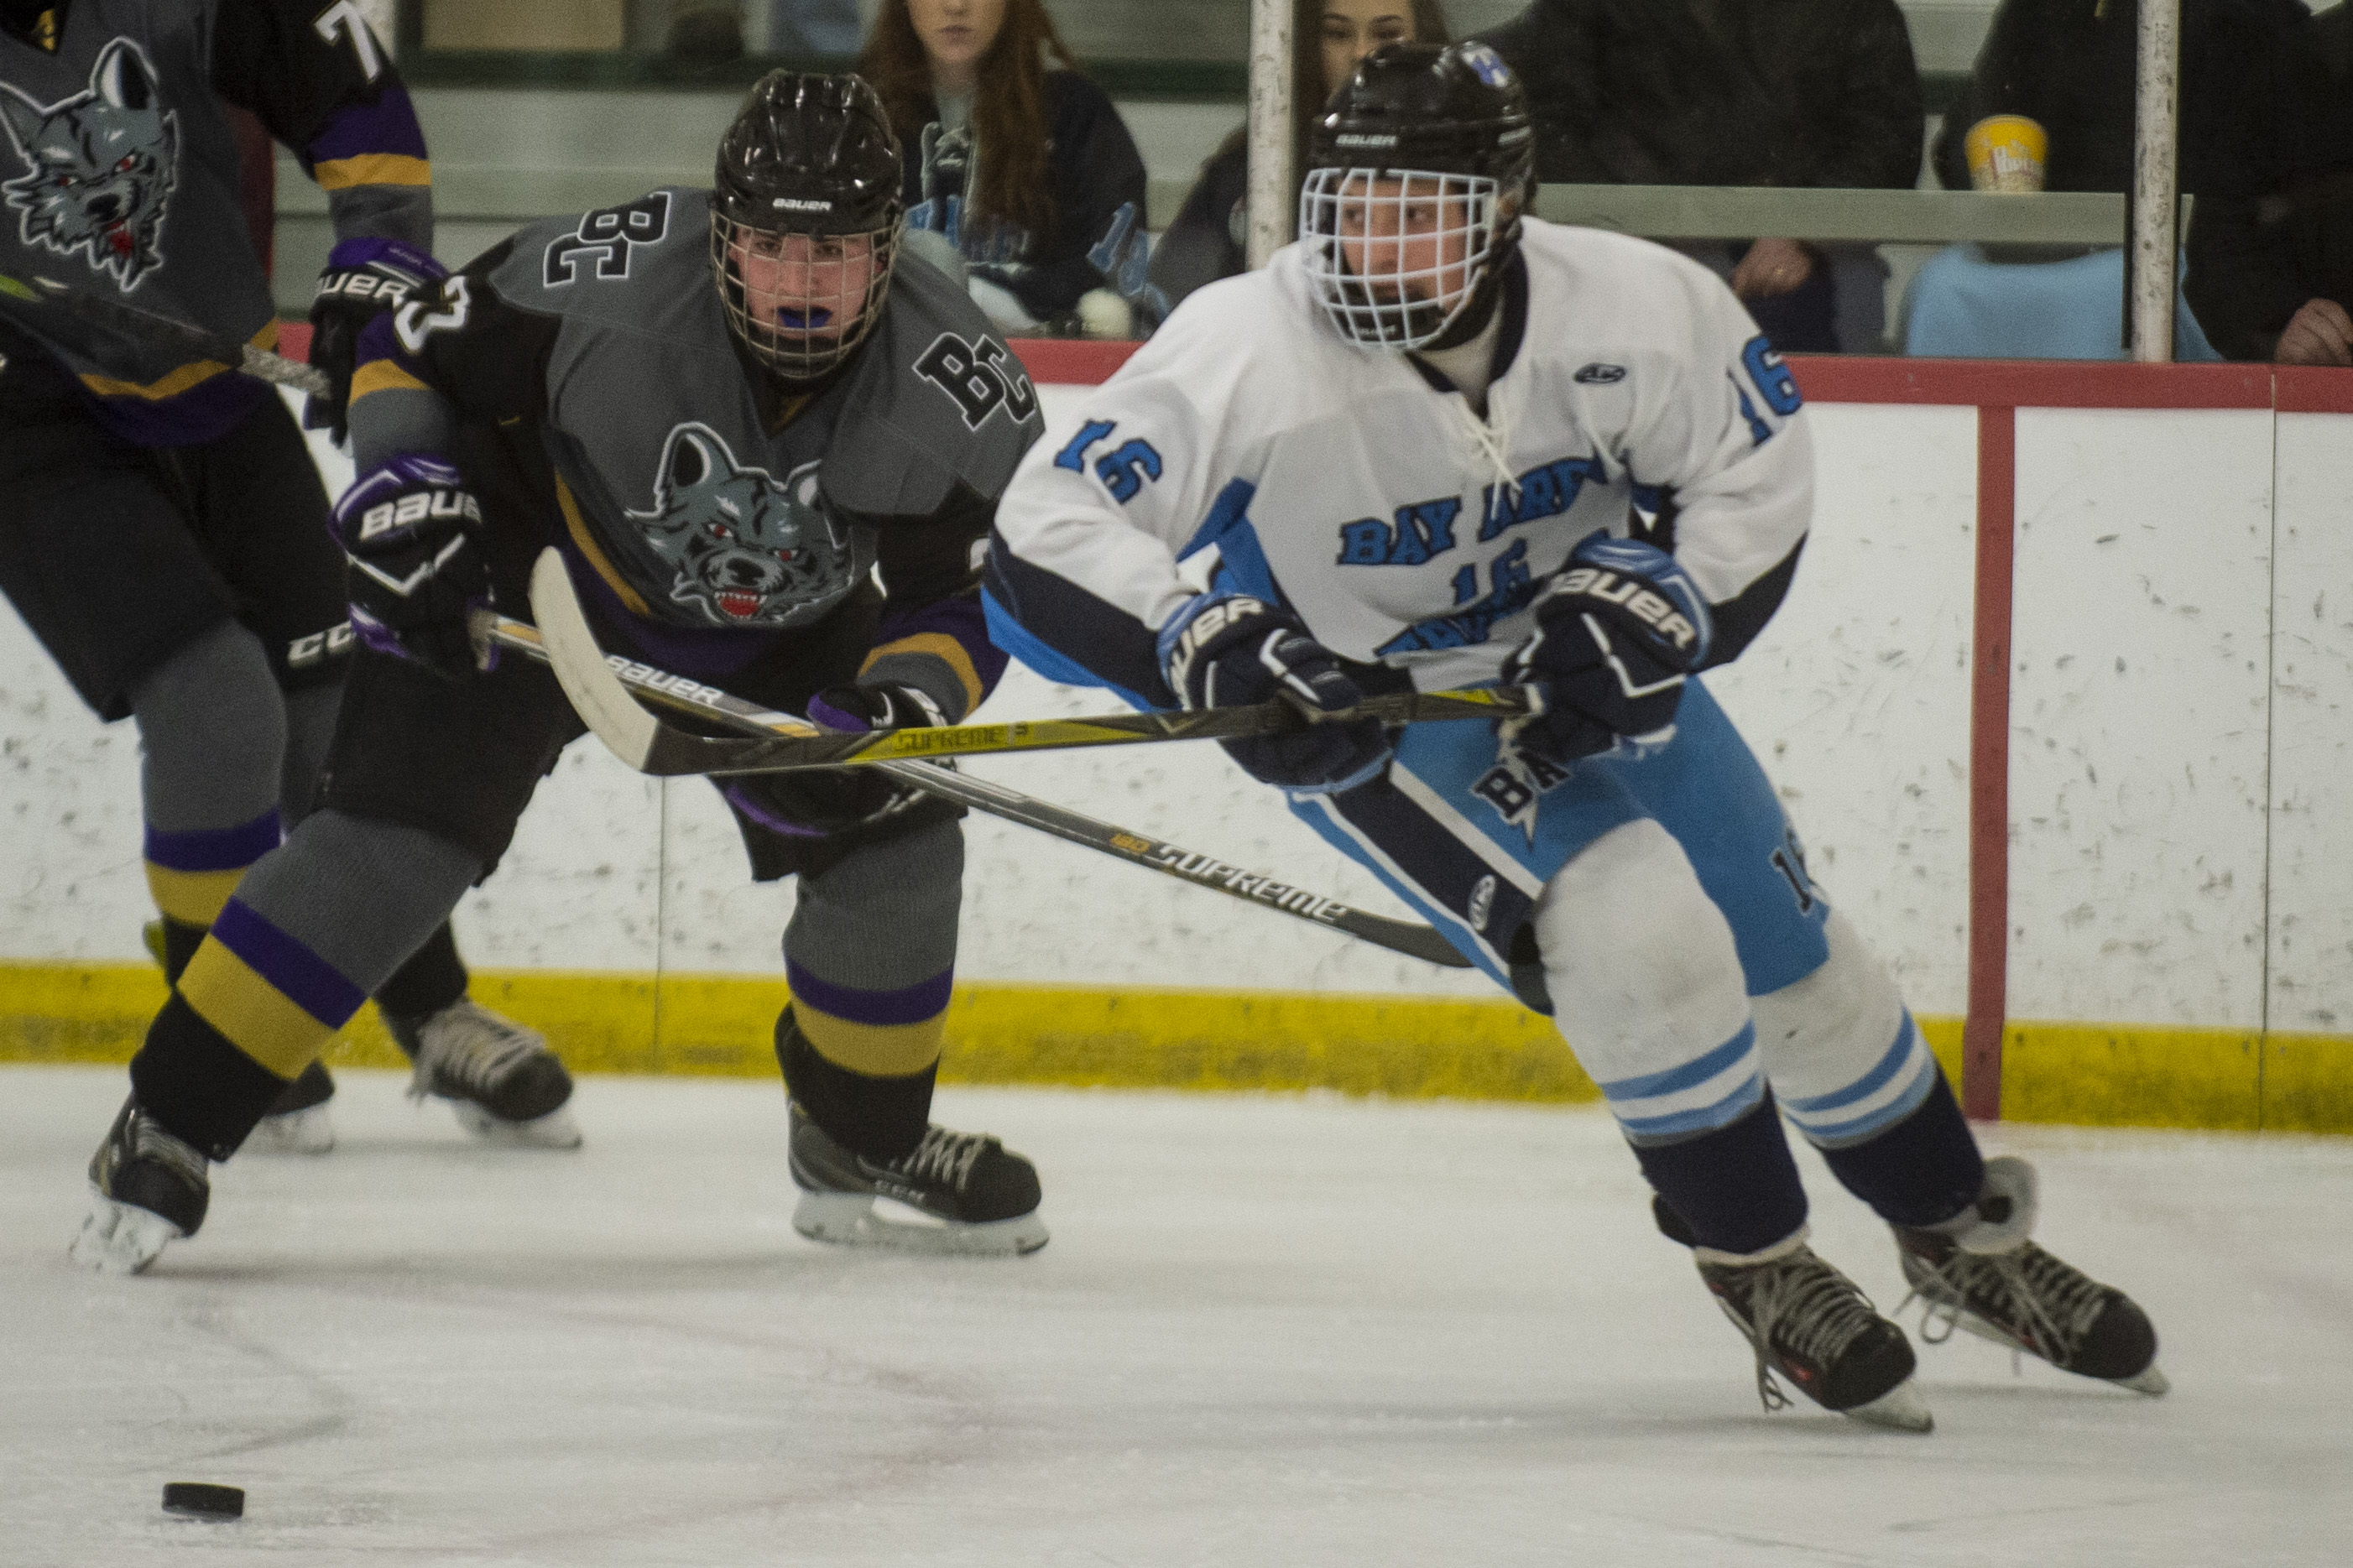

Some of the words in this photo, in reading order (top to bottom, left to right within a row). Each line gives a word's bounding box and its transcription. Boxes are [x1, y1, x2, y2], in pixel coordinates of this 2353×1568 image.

[1054, 419, 1163, 506] 16
[1336, 496, 1462, 566] BAY
[289, 621, 356, 660] CC
